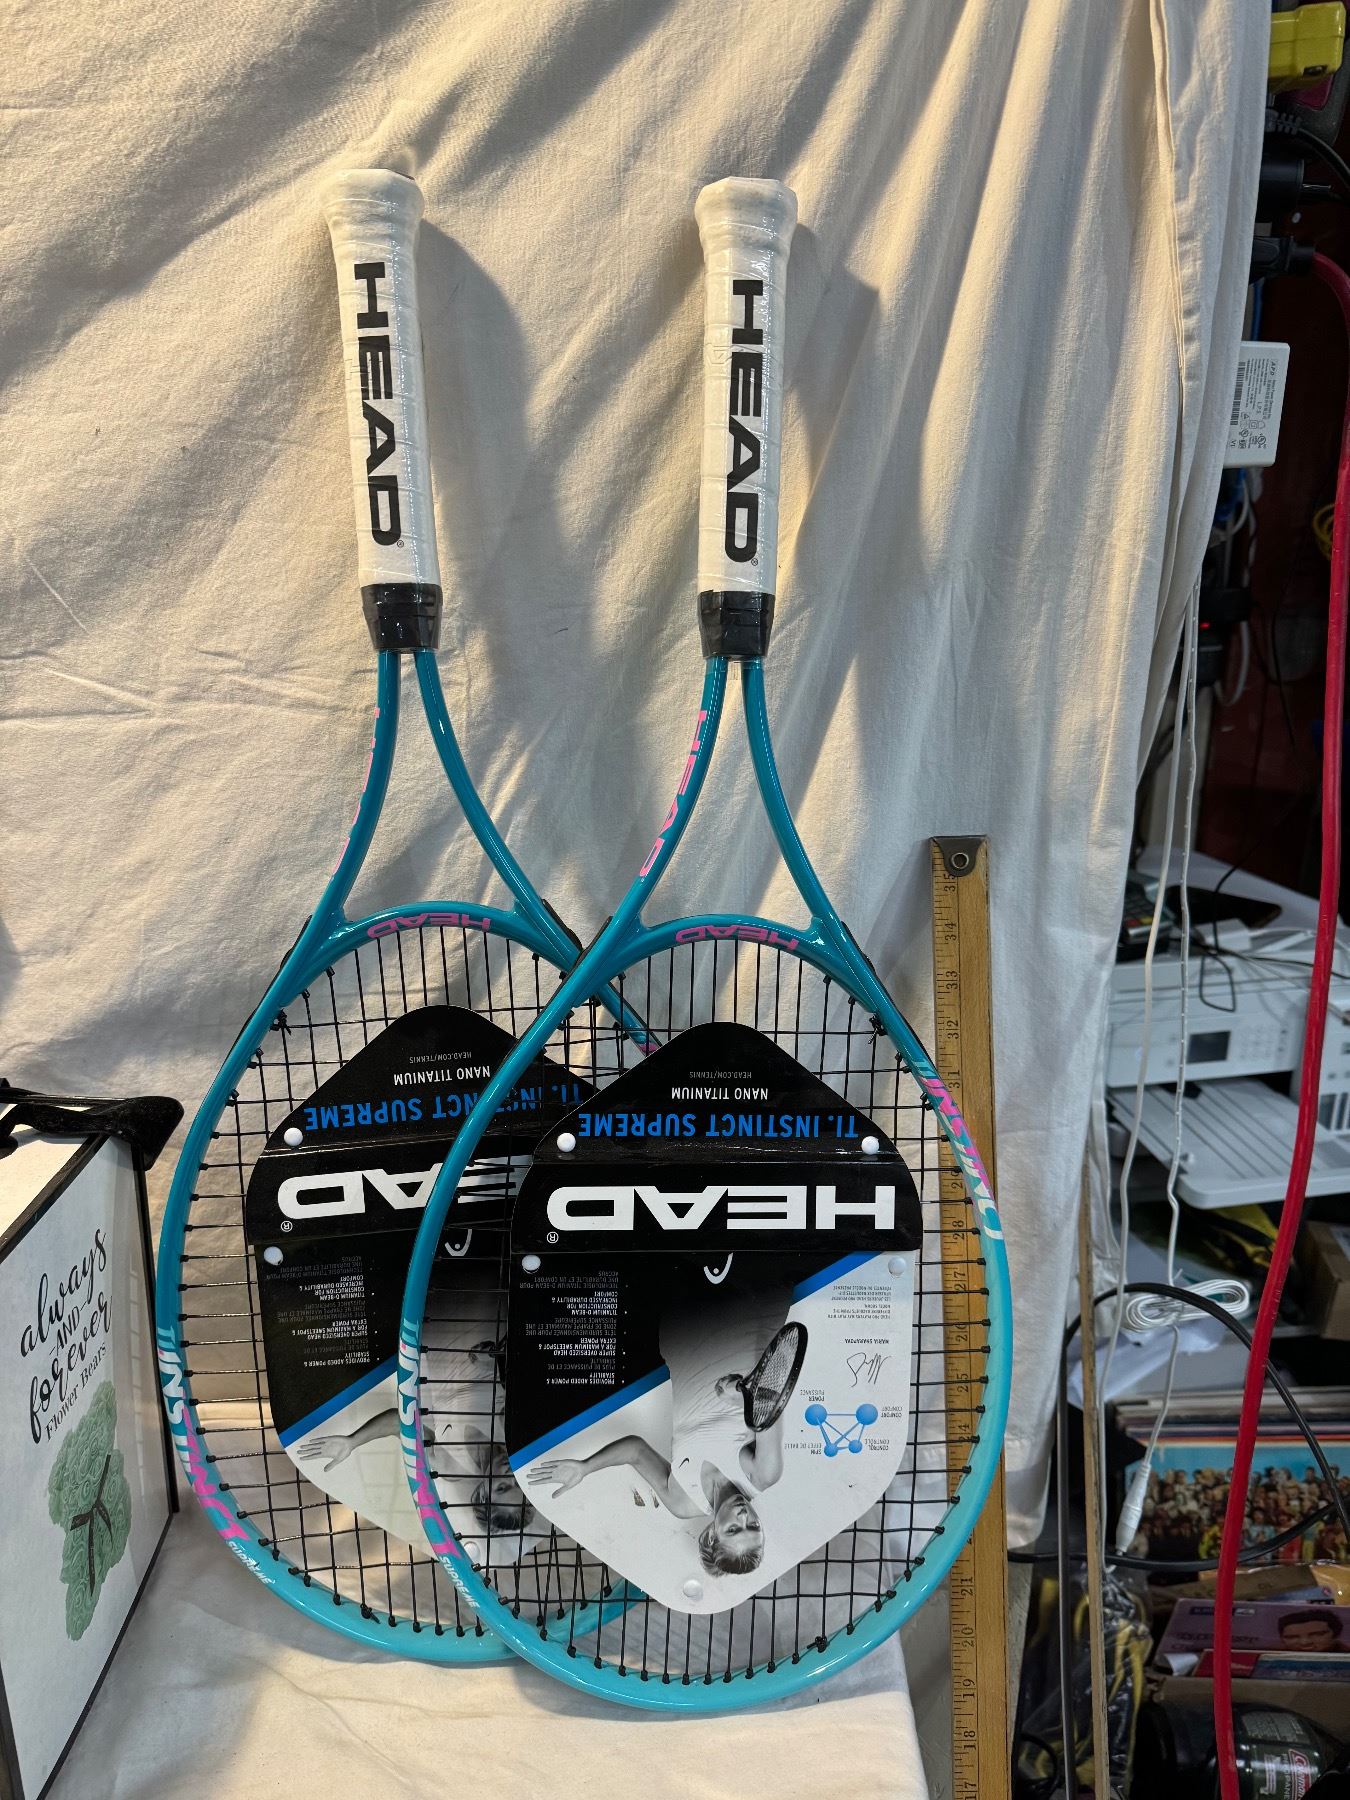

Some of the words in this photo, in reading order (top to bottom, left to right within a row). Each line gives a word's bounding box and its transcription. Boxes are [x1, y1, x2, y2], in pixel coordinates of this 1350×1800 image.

[354, 262, 401, 546] HEAD
[724, 279, 764, 563] HEAD
[366, 912, 492, 938] HEAD
[944, 922, 957, 941] 34
[676, 924, 799, 950] HEAD
[946, 970, 958, 990] 33
[947, 1019, 959, 1040] 32
[393, 1069, 452, 1086] TITANIUM
[456, 1065, 490, 1081] NANO
[689, 1071, 752, 1079] HEAD.COM/TENNIS
[948, 1070, 961, 1089] 31
[671, 1086, 730, 1100] TITANIUM
[734, 1087, 768, 1100] NANO
[303, 1098, 422, 1131] SUPREME
[578, 1113, 696, 1137] SUPREME
[700, 1114, 819, 1137] INSTINCT
[829, 1115, 858, 1138] TI.
[547, 1186, 895, 1231] HEAD
[21, 1229, 106, 1357] always
[30, 1291, 112, 1444] forever
[46, 1383, 79, 1442] Flower
[81, 1342, 107, 1389] Bears
[439, 1555, 481, 1609] SUPREME
[961, 1576, 974, 1597] 21
[961, 1626, 975, 1648] 20
[963, 1678, 976, 1700] 19
[964, 1729, 977, 1750] 18
